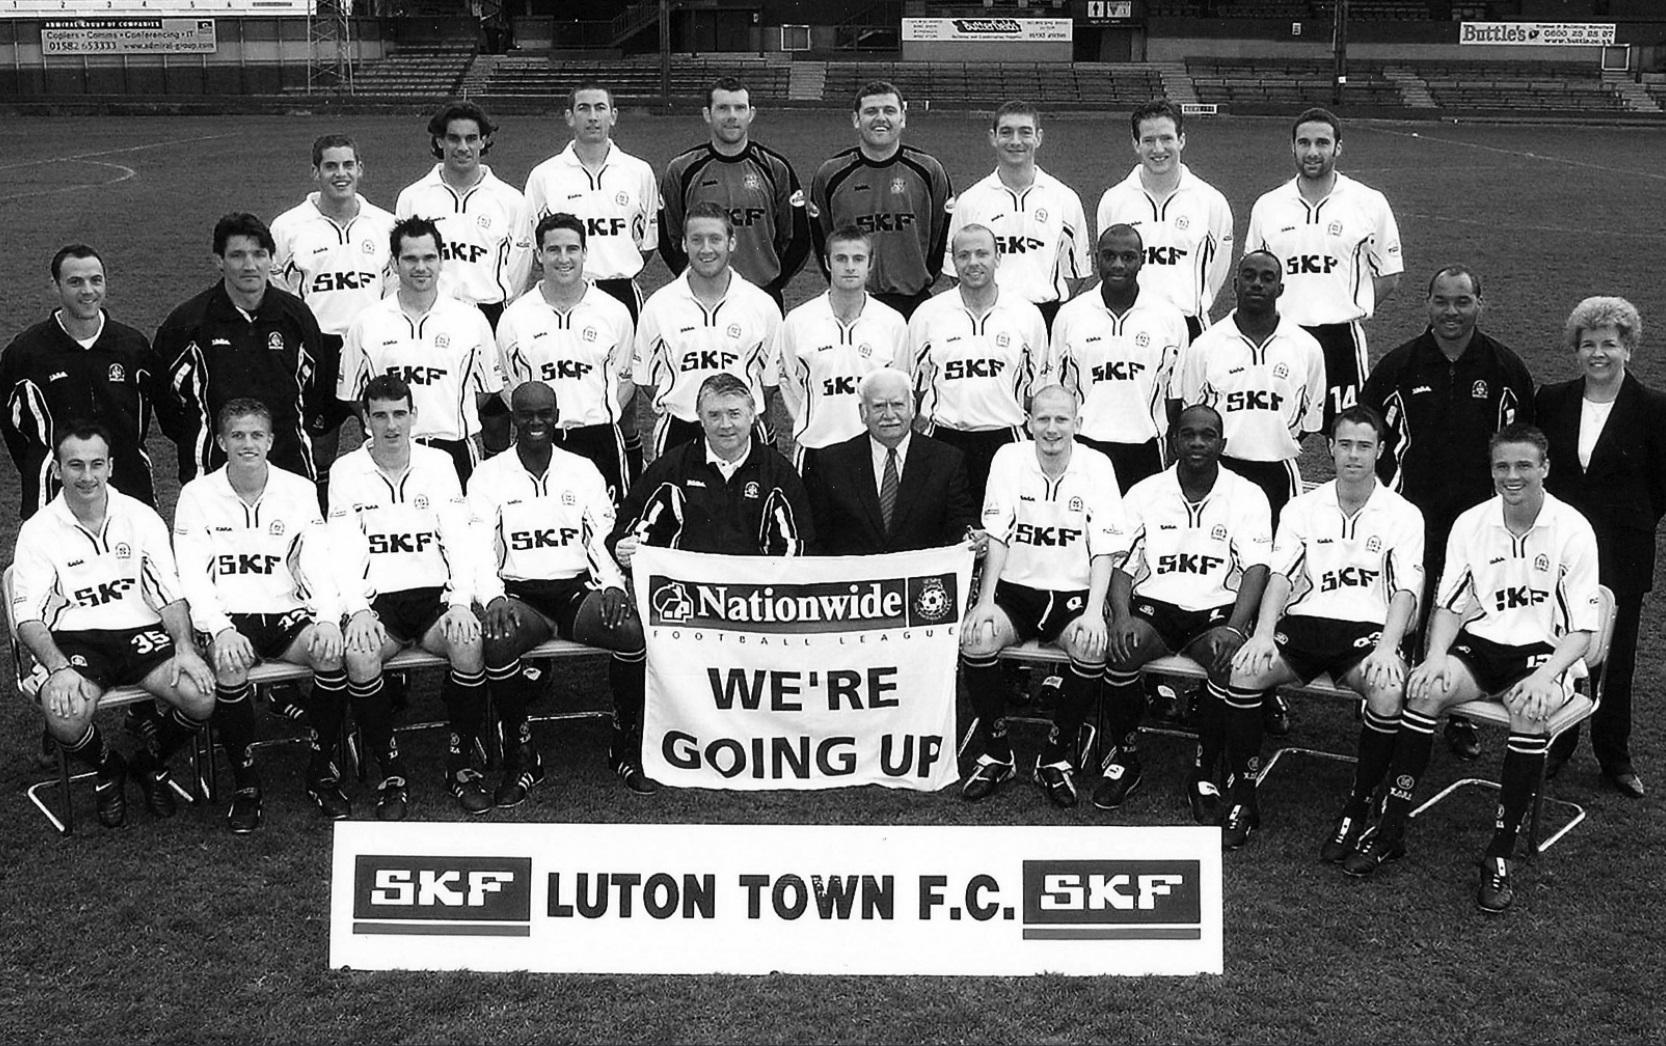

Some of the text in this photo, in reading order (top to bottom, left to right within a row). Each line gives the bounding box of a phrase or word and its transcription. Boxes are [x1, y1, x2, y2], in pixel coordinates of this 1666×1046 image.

[46, 31, 79, 40] Copiers
[87, 31, 118, 39] Comms
[125, 31, 180, 40] Conferencing
[1462, 24, 1526, 42] Buttle's
[49, 41, 79, 51] 01582
[587, 218, 626, 236] KF
[856, 213, 915, 233] SKF
[1143, 246, 1187, 265] KF
[312, 271, 376, 293] SKF
[541, 360, 593, 381] SKF
[681, 350, 739, 372] SKF
[945, 358, 1005, 380] SKF
[1091, 361, 1146, 384] SKF
[822, 376, 862, 396] SK
[1329, 384, 1358, 414] 14
[368, 532, 433, 553] SKF
[511, 528, 579, 550] SKF
[1015, 523, 1082, 547] SKF
[219, 554, 281, 575] SKF
[1157, 553, 1224, 575] SKF
[1321, 567, 1380, 592] SKF
[696, 583, 902, 622] Nationwide
[130, 630, 172, 655] 35
[653, 627, 955, 646] FOOTBALL LEAGUE
[707, 666, 899, 711] WE'RE
[662, 730, 943, 779] GOING UP
[371, 870, 514, 906] SKF
[547, 872, 1015, 921] LUTON TOWN F.C.
[1040, 874, 1182, 910] SKF
